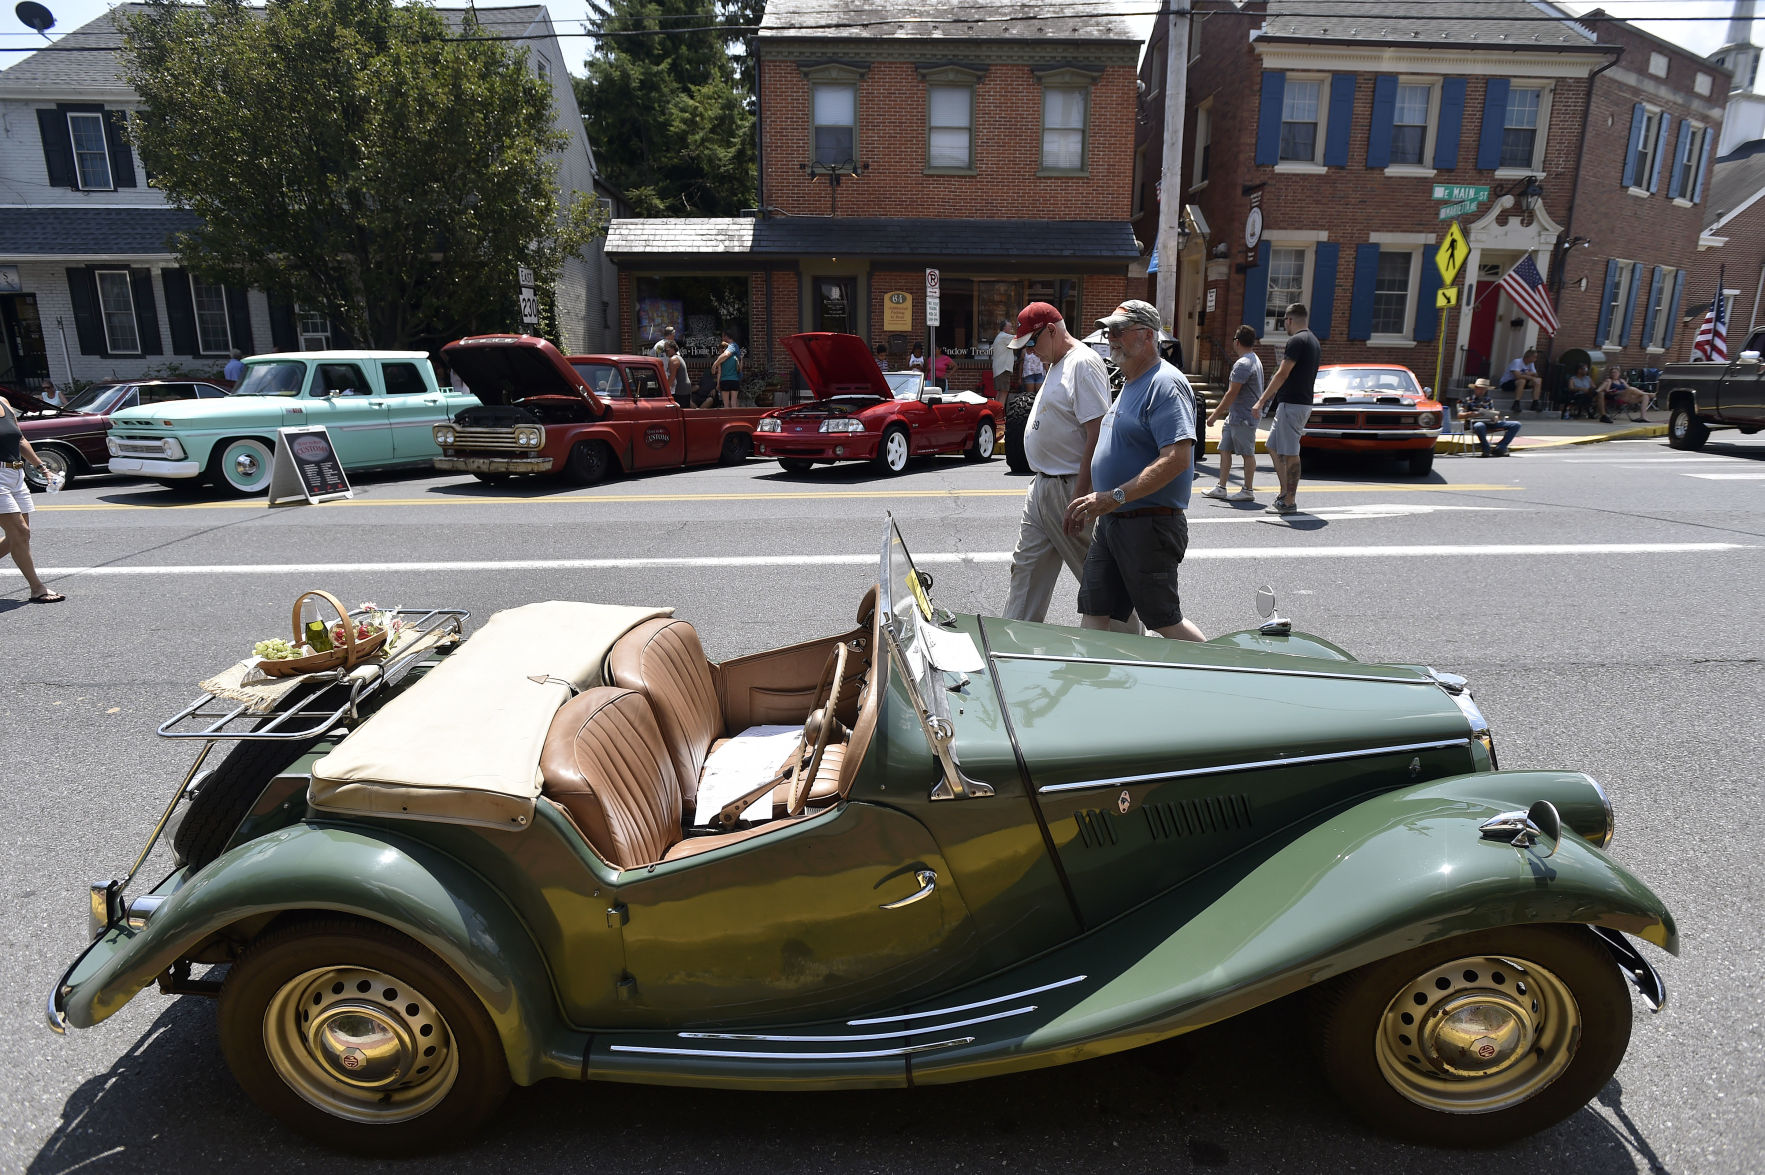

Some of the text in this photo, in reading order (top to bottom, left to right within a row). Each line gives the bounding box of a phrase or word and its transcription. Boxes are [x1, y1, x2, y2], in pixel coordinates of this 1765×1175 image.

[1444, 187, 1488, 200] E MAIN ST
[520, 270, 533, 284] EAST
[522, 297, 537, 318] 230
[691, 346, 710, 356] Home
